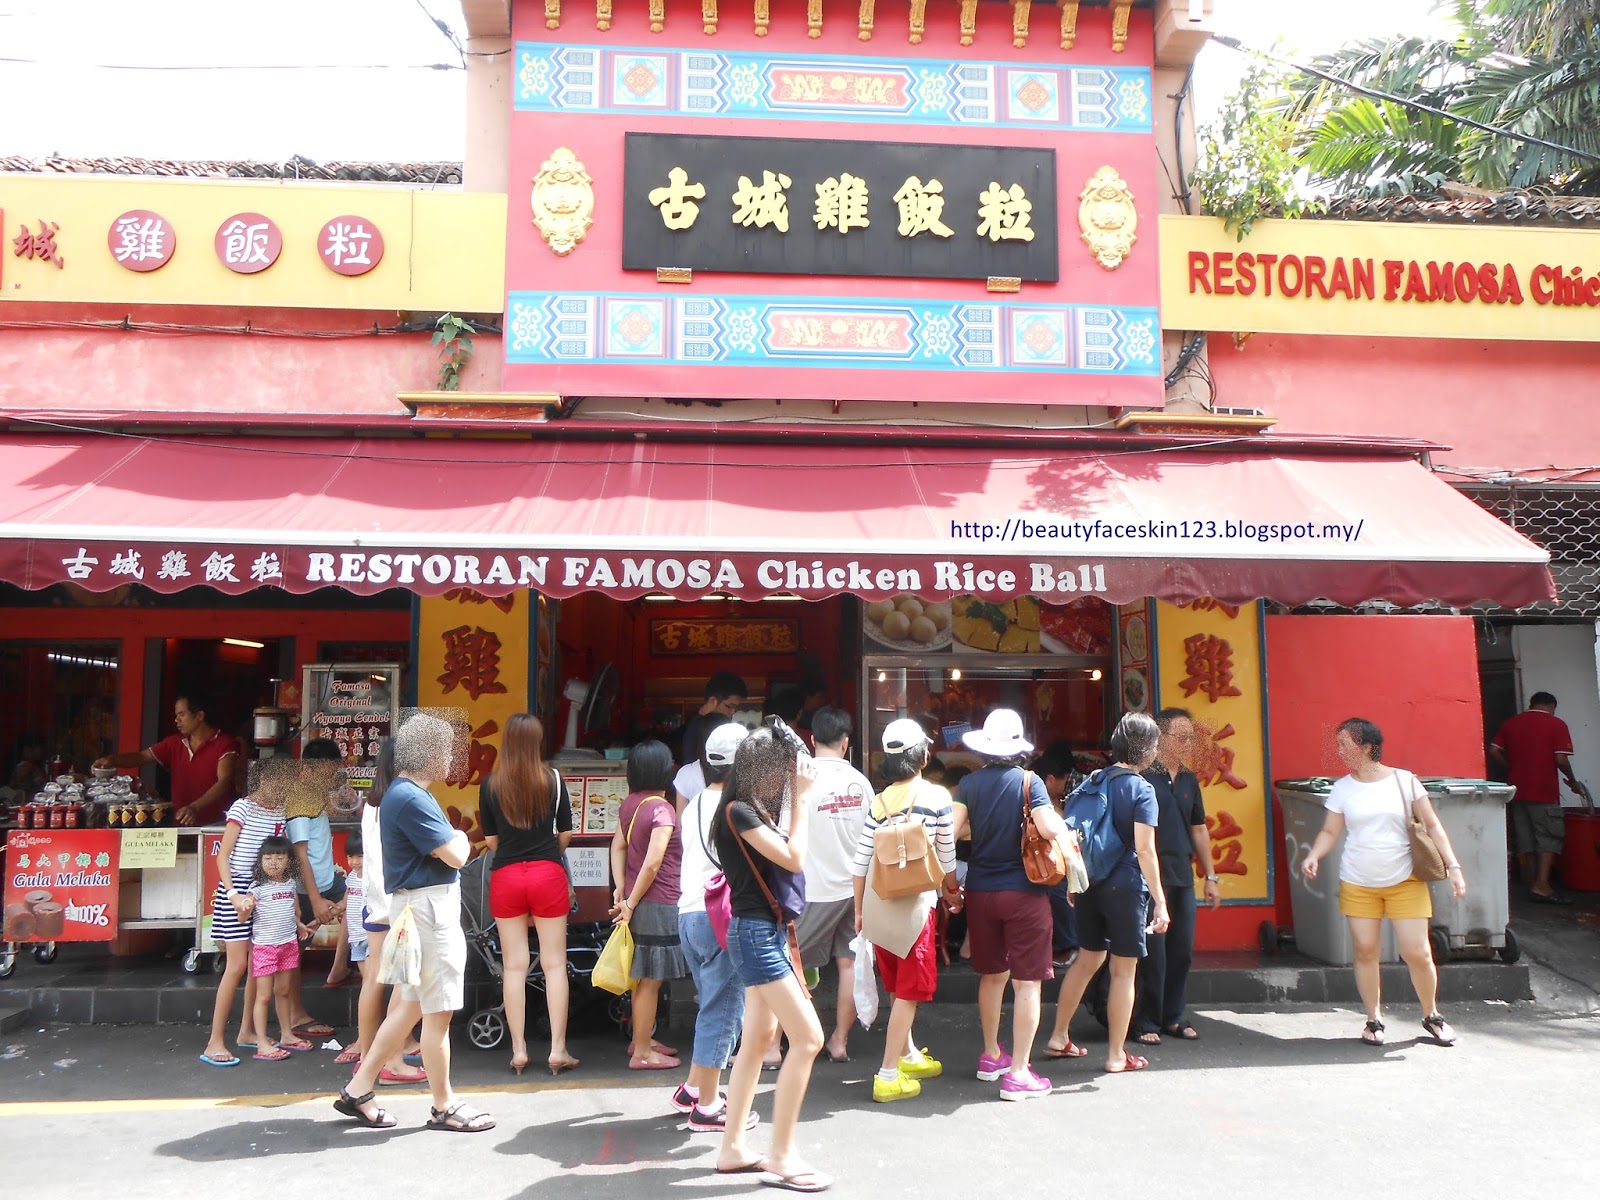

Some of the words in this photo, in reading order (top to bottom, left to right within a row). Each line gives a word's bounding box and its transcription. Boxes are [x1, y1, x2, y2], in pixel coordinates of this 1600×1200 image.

[648, 166, 1035, 242] 古城雞飯粒
[1188, 250, 1375, 300] RESTORAN
[1382, 259, 1524, 306] FAMOSA
[1530, 264, 1600, 307] Chic
[62, 547, 283, 583] 古城雞飯粒
[305, 552, 549, 587] RESTORAN
[563, 555, 744, 590] FAMOSA
[757, 559, 921, 592] Chicken
[934, 560, 1016, 592] Rice
[1030, 562, 1108, 593] Ball
[331, 680, 371, 693] Famosa
[329, 696, 372, 708] Original
[313, 712, 351, 725] Nyonya
[354, 711, 390, 723] Cendol
[13, 871, 51, 888] Gula
[54, 870, 111, 887] Melaka
